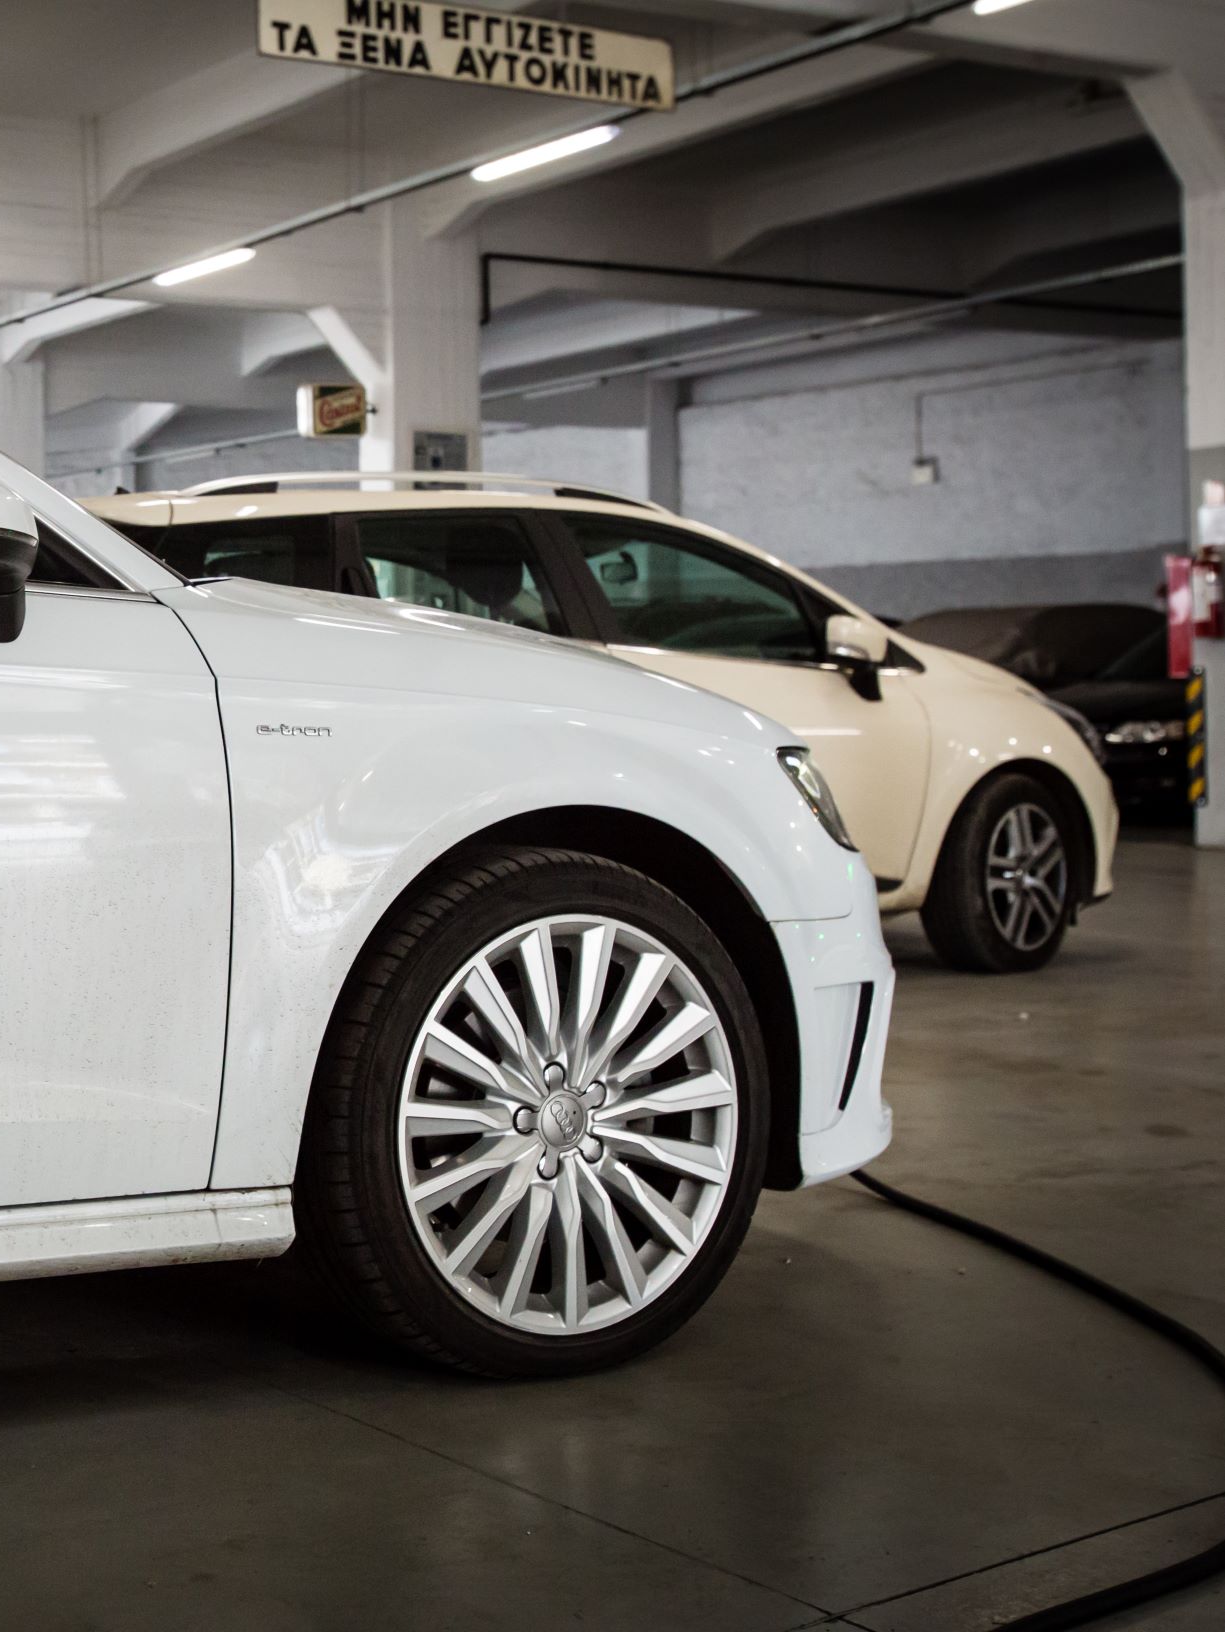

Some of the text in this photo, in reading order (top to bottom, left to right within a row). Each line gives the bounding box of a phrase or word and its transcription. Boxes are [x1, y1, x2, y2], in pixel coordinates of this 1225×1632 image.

[344, 0, 597, 61] ΜΗΝ ΕΓΓΙΖΕΤΕ
[271, 21, 662, 104] ΤΑ ΞΕΝΑ ΑΥΤΟΚΙΝΗΤΑ
[256, 723, 332, 737] e-tron
